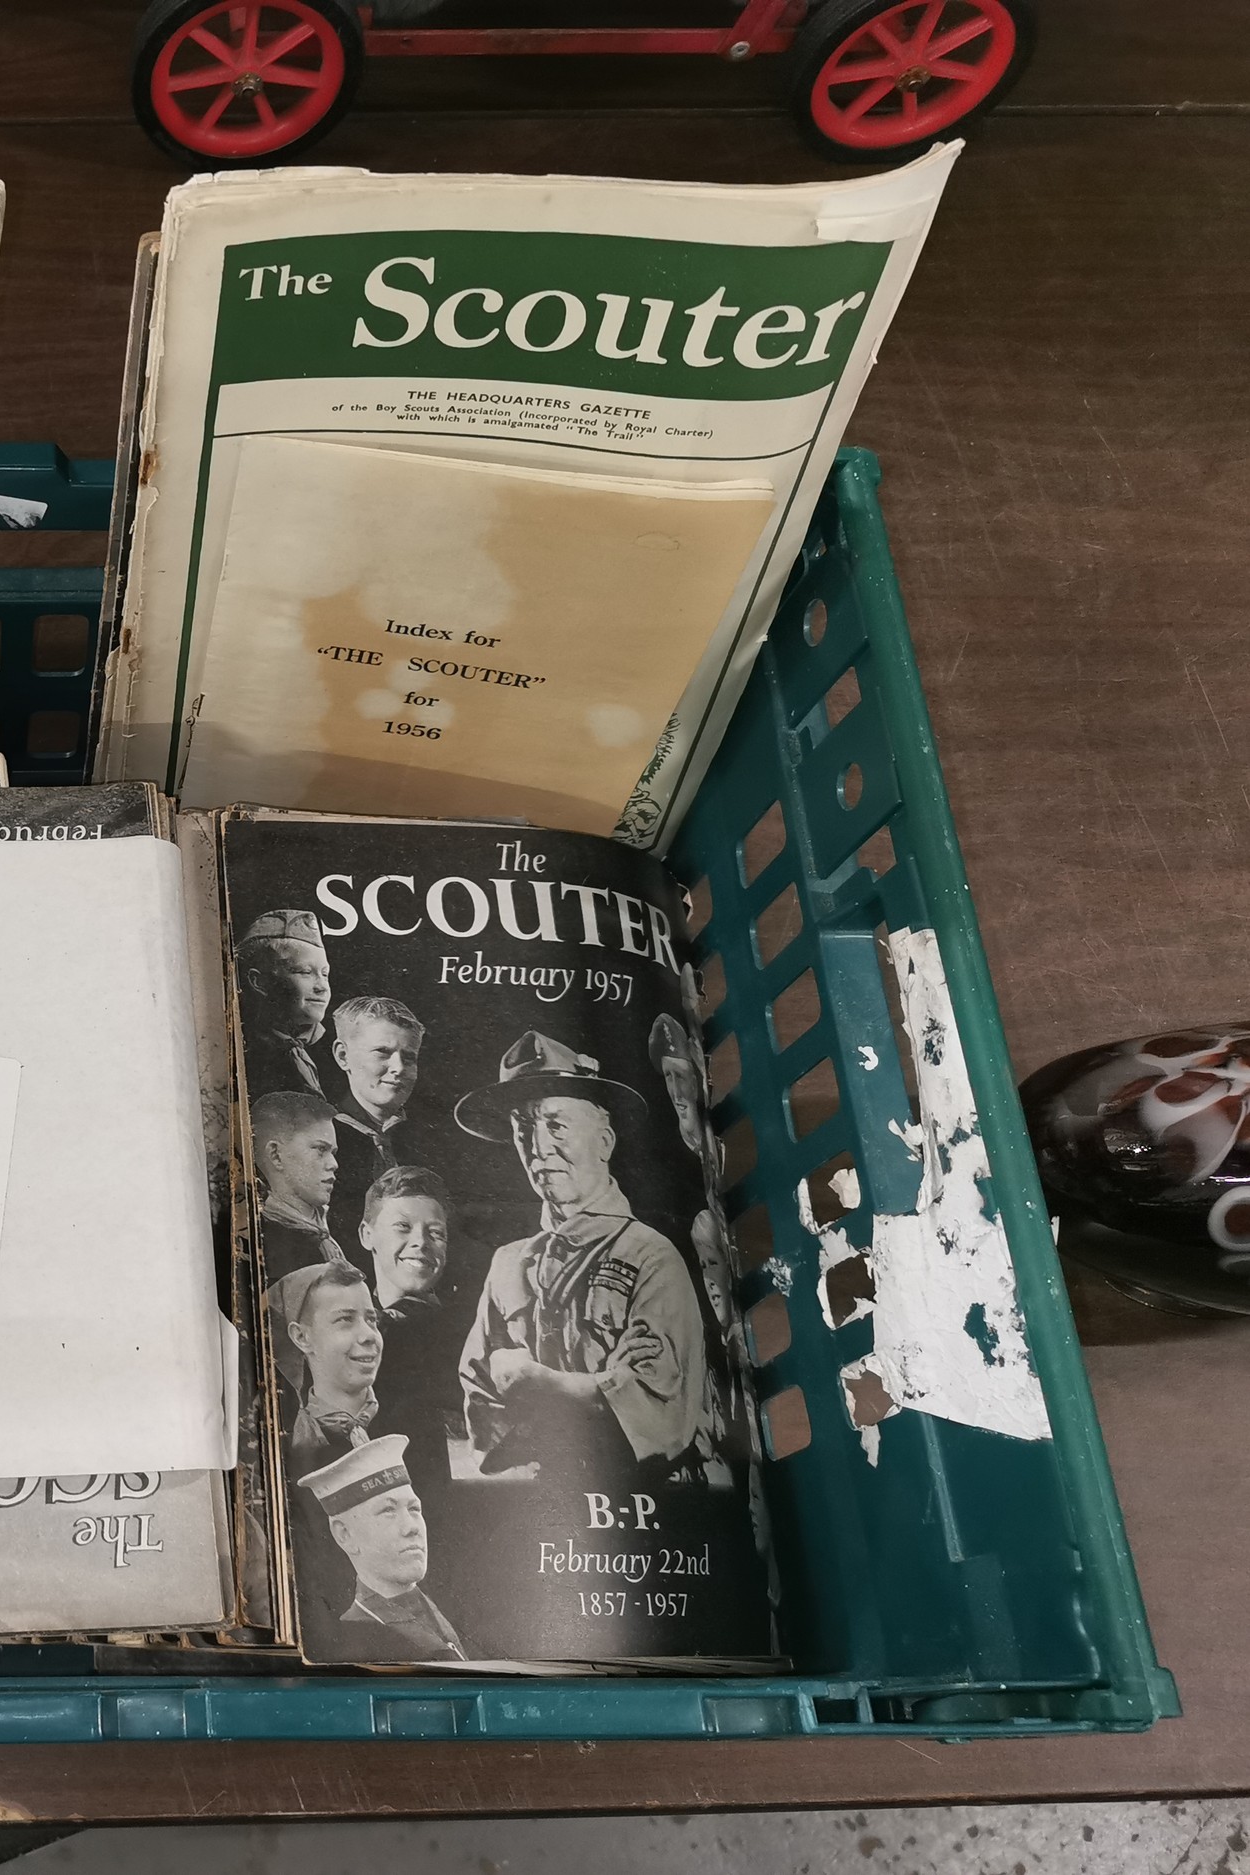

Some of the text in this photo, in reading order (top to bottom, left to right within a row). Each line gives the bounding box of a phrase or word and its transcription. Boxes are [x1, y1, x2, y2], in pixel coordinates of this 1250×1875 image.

[239, 255, 866, 370] The Scouter
[332, 404, 713, 440] of the Boy Scouts Association (Incorporated by Royal Charter)
[396, 413, 421, 422] with
[429, 414, 461, 423] which
[468, 416, 476, 424] is
[483, 417, 559, 432] amalgamated
[407, 391, 651, 420] THE HEADQUARTERS GAZETTE
[385, 619, 501, 648] Index for
[318, 646, 546, 689] “THE SCOUTER”
[403, 692, 439, 707] for
[382, 721, 442, 740] 1956
[496, 841, 547, 873] The
[315, 873, 681, 976] SCOUTER
[437, 951, 634, 1007] February 1957
[584, 1493, 660, 1530] B.-P.
[72, 1513, 164, 1568] The
[537, 1539, 710, 1583] February 22nd
